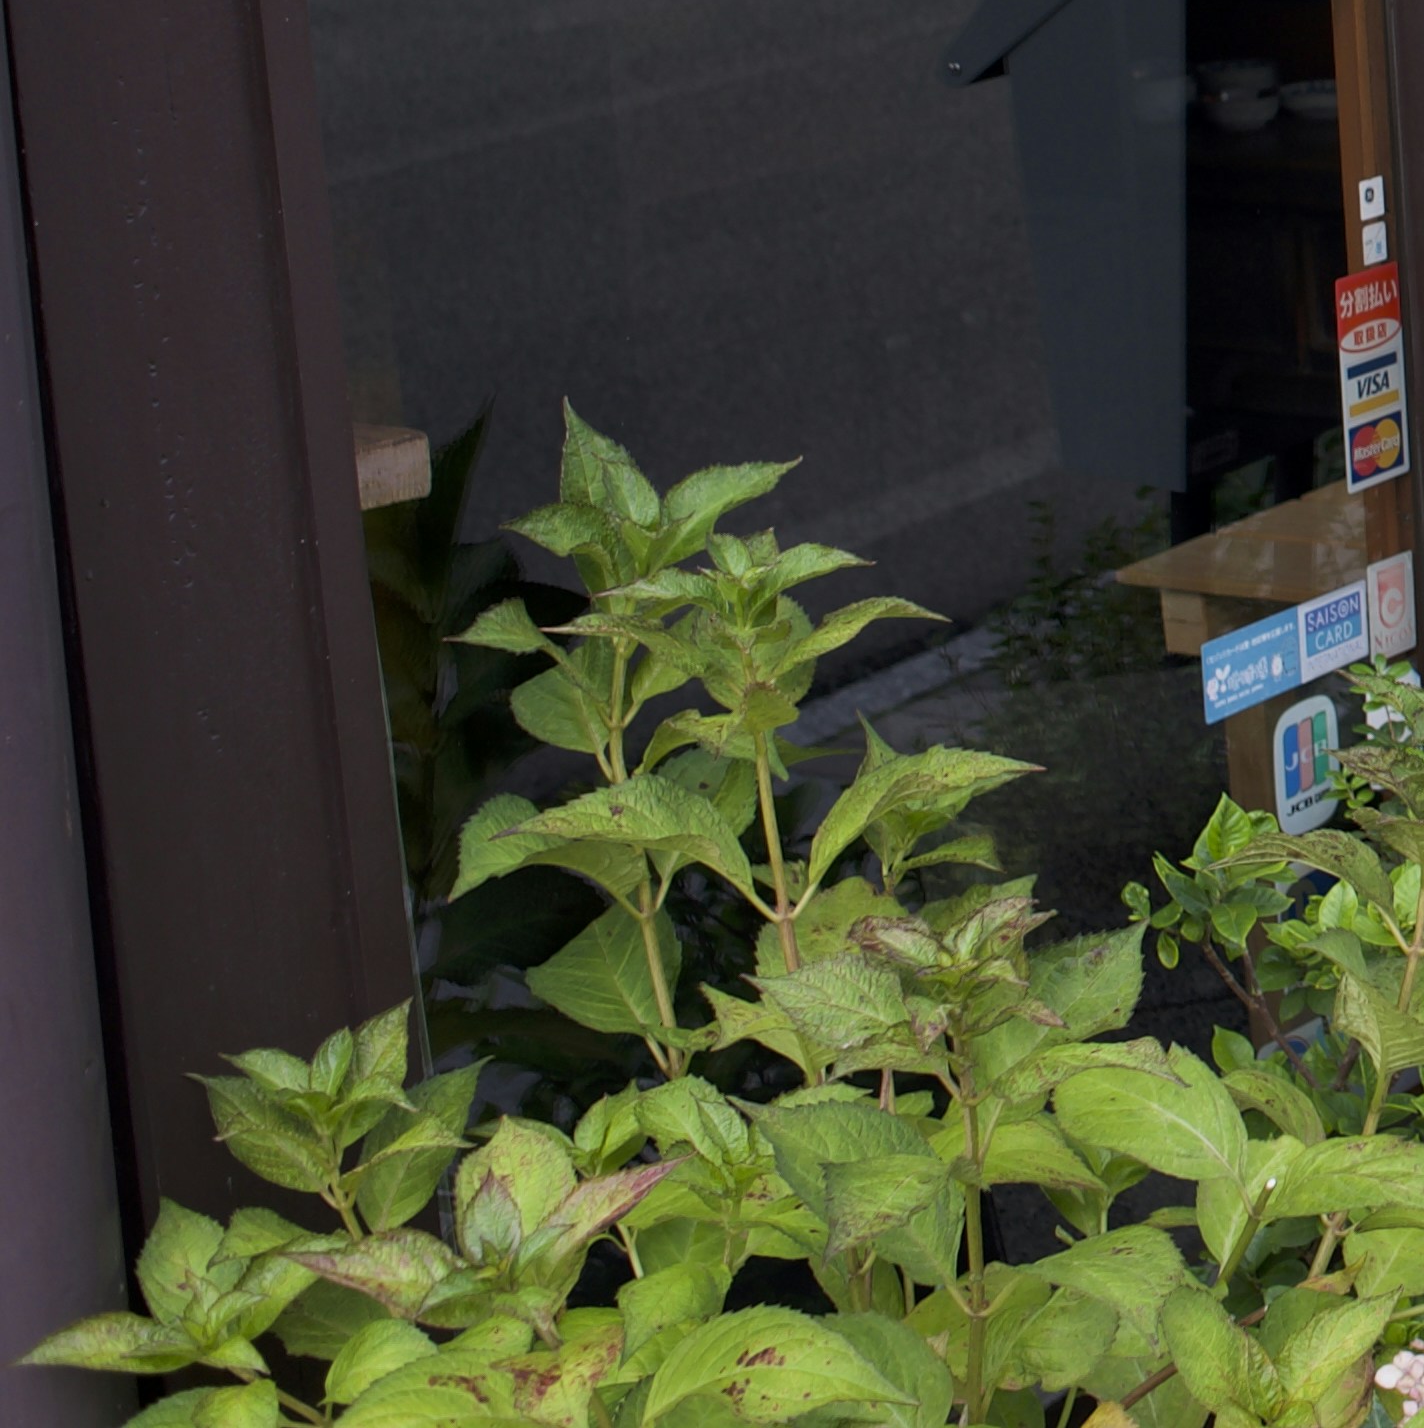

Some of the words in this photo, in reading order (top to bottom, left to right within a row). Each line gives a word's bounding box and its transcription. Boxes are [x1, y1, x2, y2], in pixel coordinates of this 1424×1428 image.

[1340, 278, 1398, 319] 分割払い
[1356, 370, 1391, 400] VISA
[1353, 434, 1400, 462] MasterCard
[1307, 593, 1360, 632] SAISON
[1315, 620, 1353, 650] CARD
[1286, 795, 1314, 817] JCB
